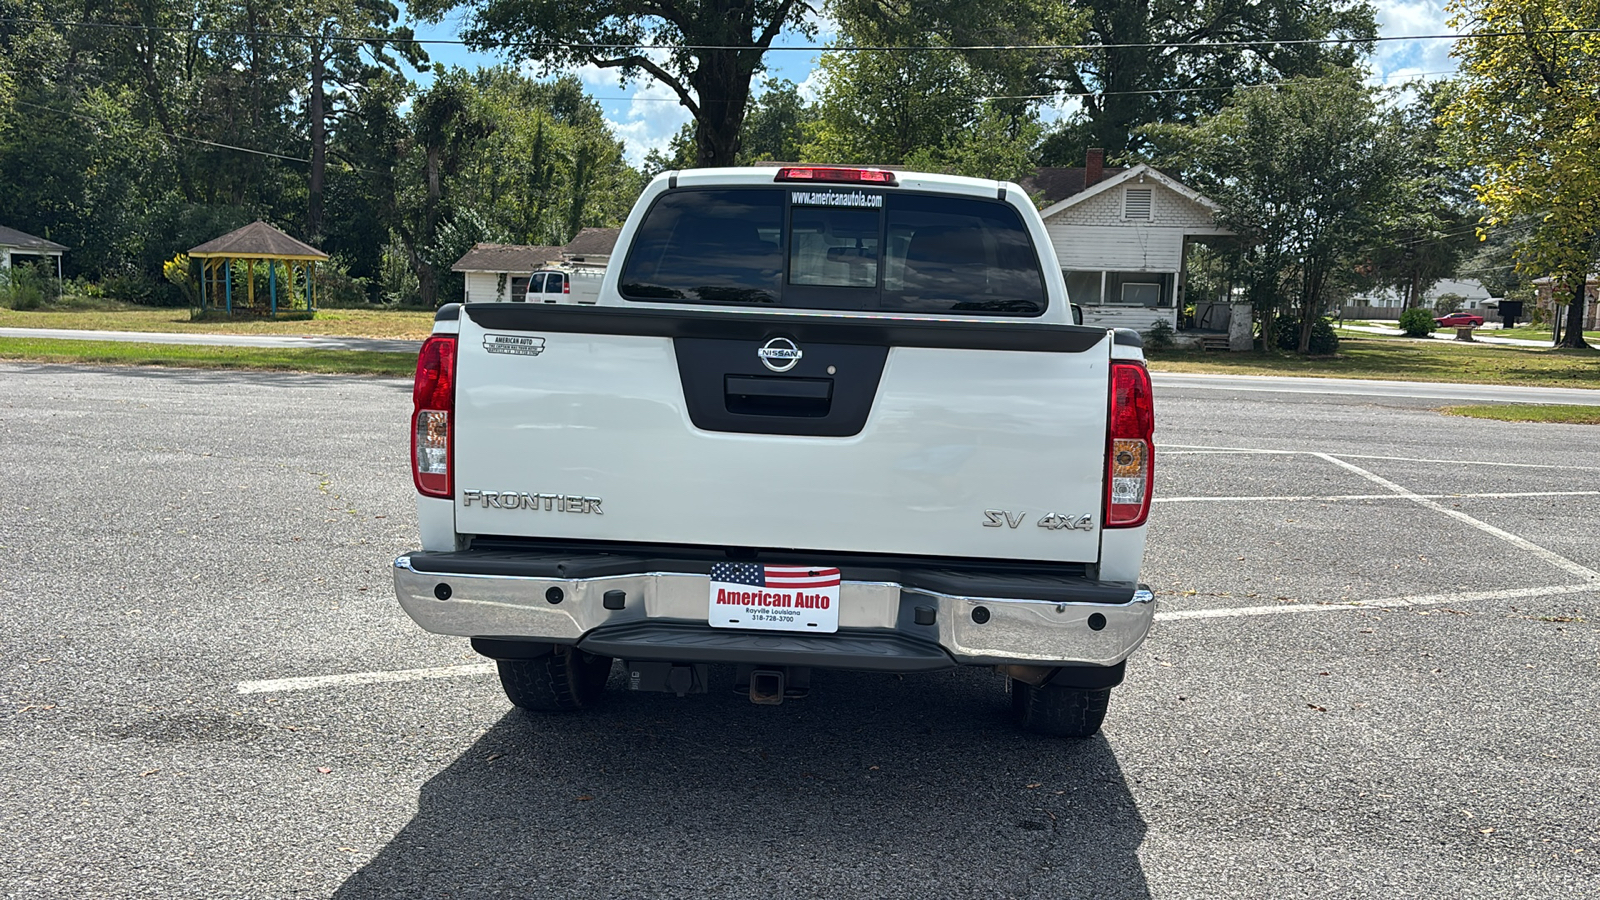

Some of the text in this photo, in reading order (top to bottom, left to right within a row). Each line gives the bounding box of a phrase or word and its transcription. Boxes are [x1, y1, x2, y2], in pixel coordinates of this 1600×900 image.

[791, 189, 882, 207] www.americanautola.com
[463, 488, 604, 515] FRONTIER
[982, 509, 1026, 529] SV
[716, 588, 830, 609] American Auto
[745, 607, 801, 616] Rayville Louisiana
[751, 614, 794, 622] 318-728-3700
